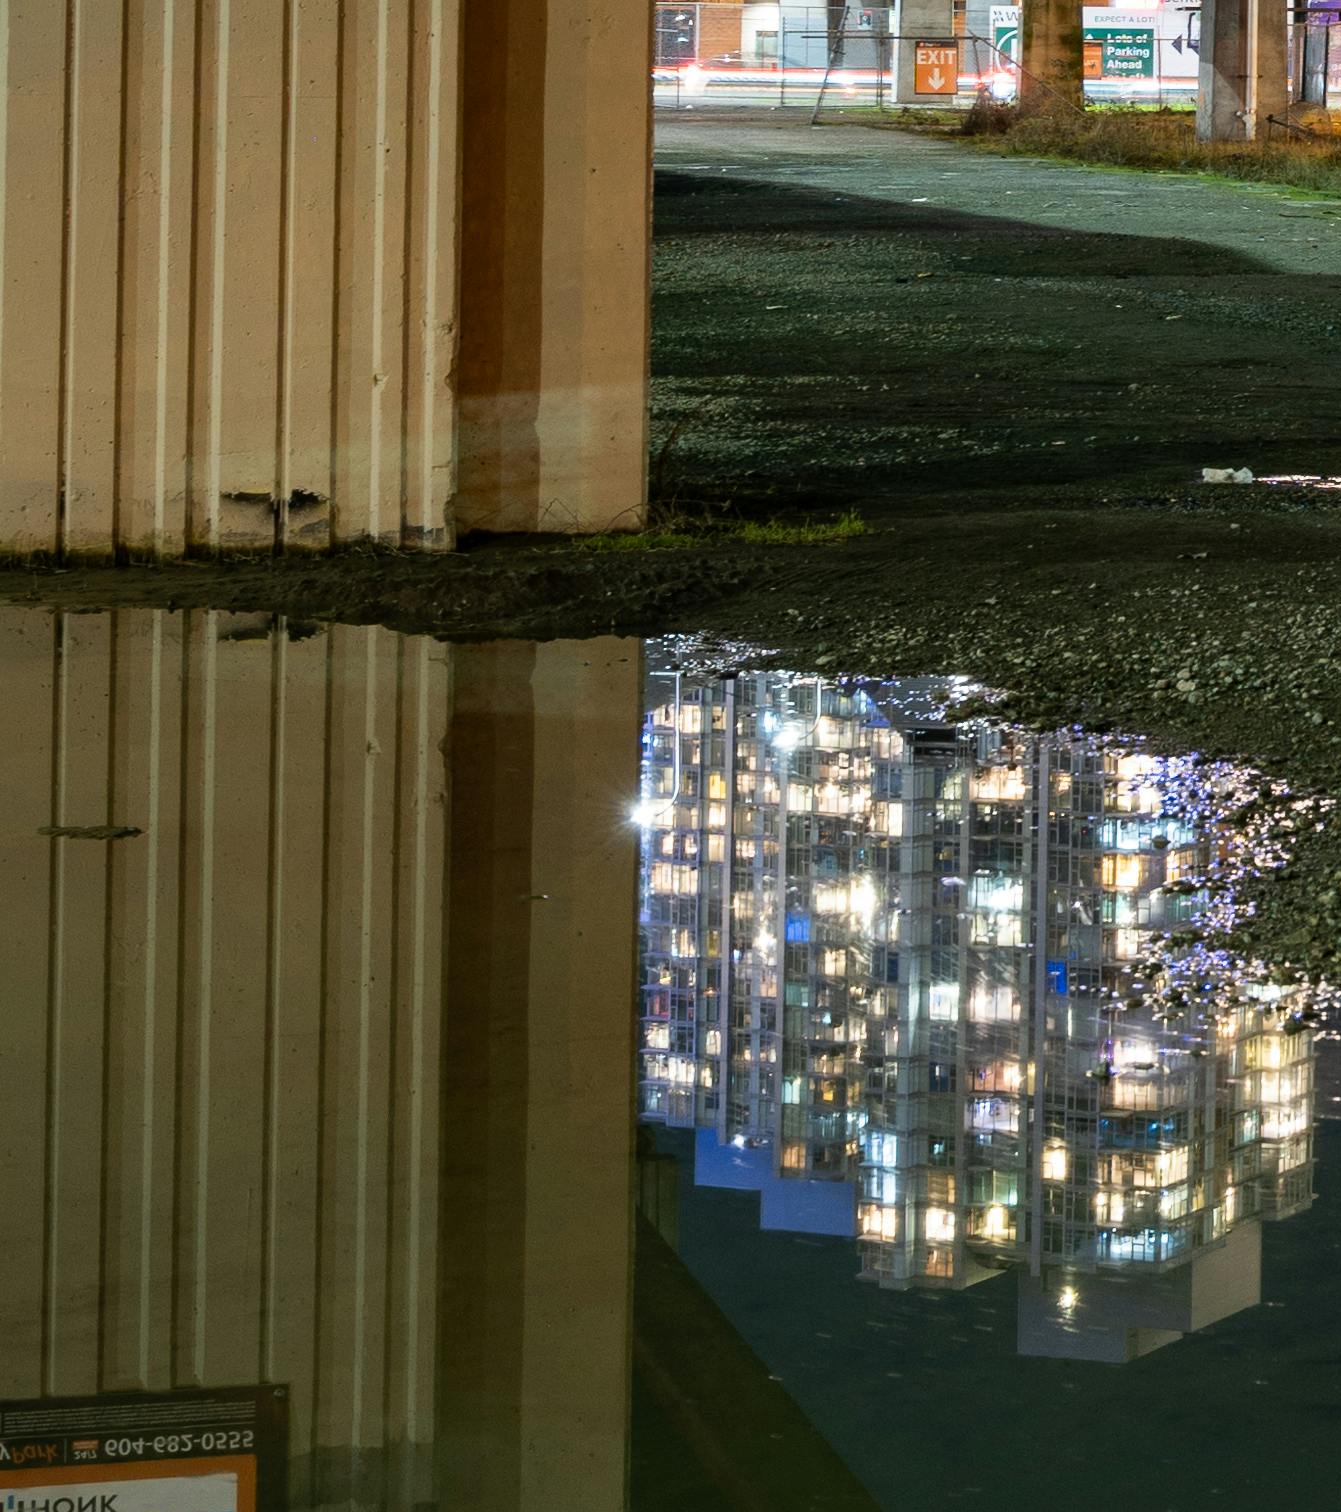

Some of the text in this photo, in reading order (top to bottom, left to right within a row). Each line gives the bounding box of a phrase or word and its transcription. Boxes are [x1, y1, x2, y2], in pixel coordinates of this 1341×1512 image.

[1094, 15, 1126, 23] EXPECT
[1107, 33, 1148, 43] Lots of
[917, 50, 957, 64] EXIT
[1107, 46, 1150, 58] Parking
[1107, 59, 1142, 69] Ahead
